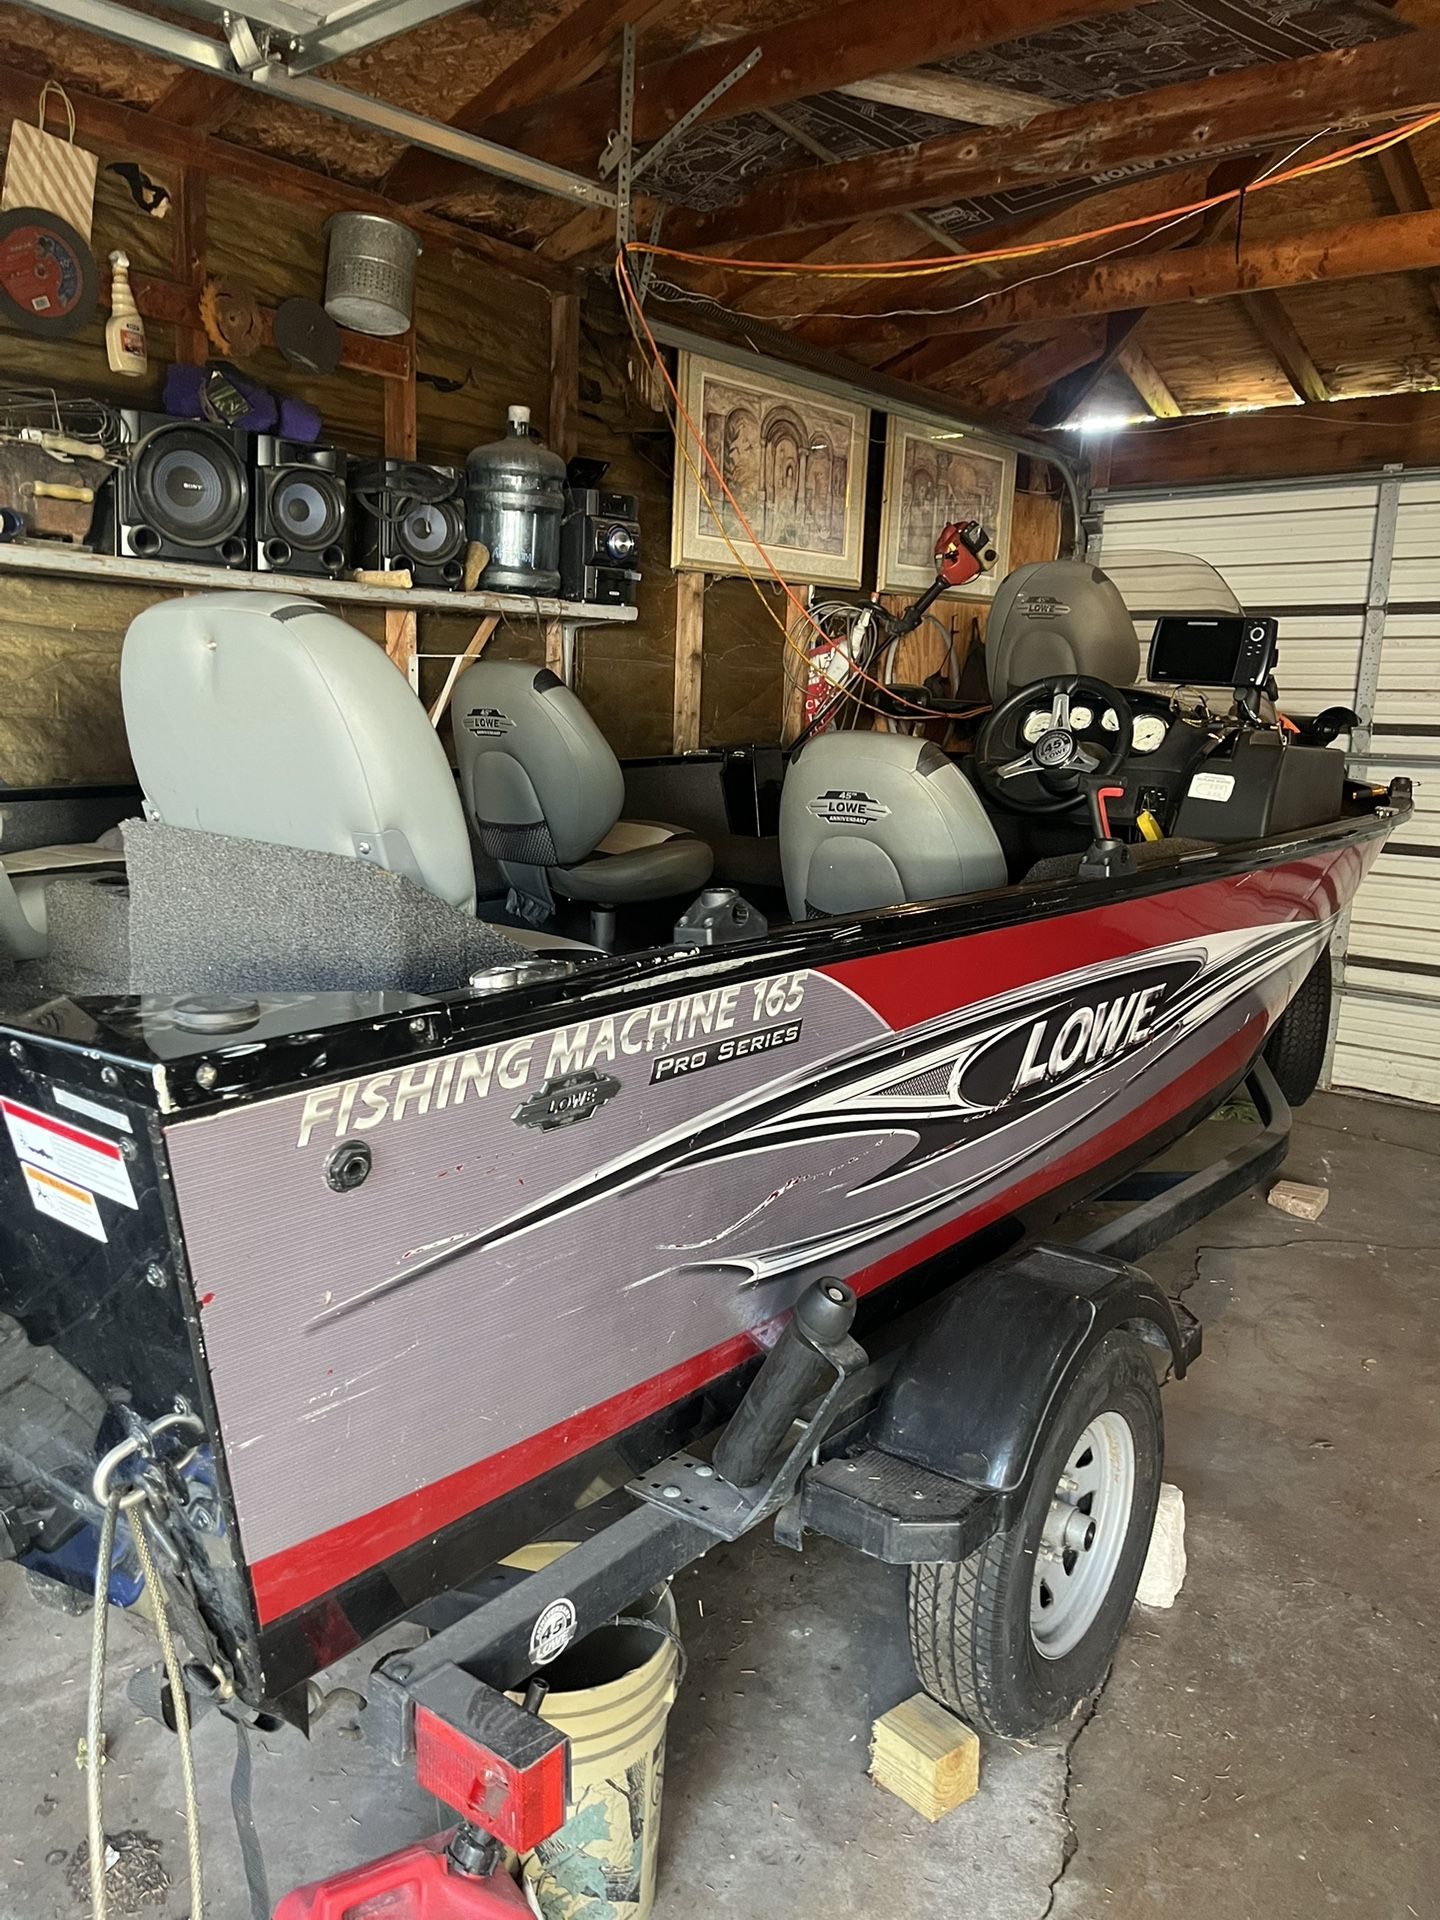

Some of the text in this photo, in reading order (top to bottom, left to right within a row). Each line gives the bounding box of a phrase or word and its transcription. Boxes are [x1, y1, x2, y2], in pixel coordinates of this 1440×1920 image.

[1028, 604, 1056, 613] LOWE
[474, 718, 500, 728] LOWE
[828, 802, 867, 814] LOWE
[829, 815, 868, 824] ANNIVERSARY
[1011, 982, 1168, 1092] LOWE
[297, 971, 810, 1148] FISHING MACHINE 165
[654, 1025, 800, 1080] PRO SERIES
[541, 1616, 564, 1640] 45
[535, 1632, 571, 1660] LOWE
